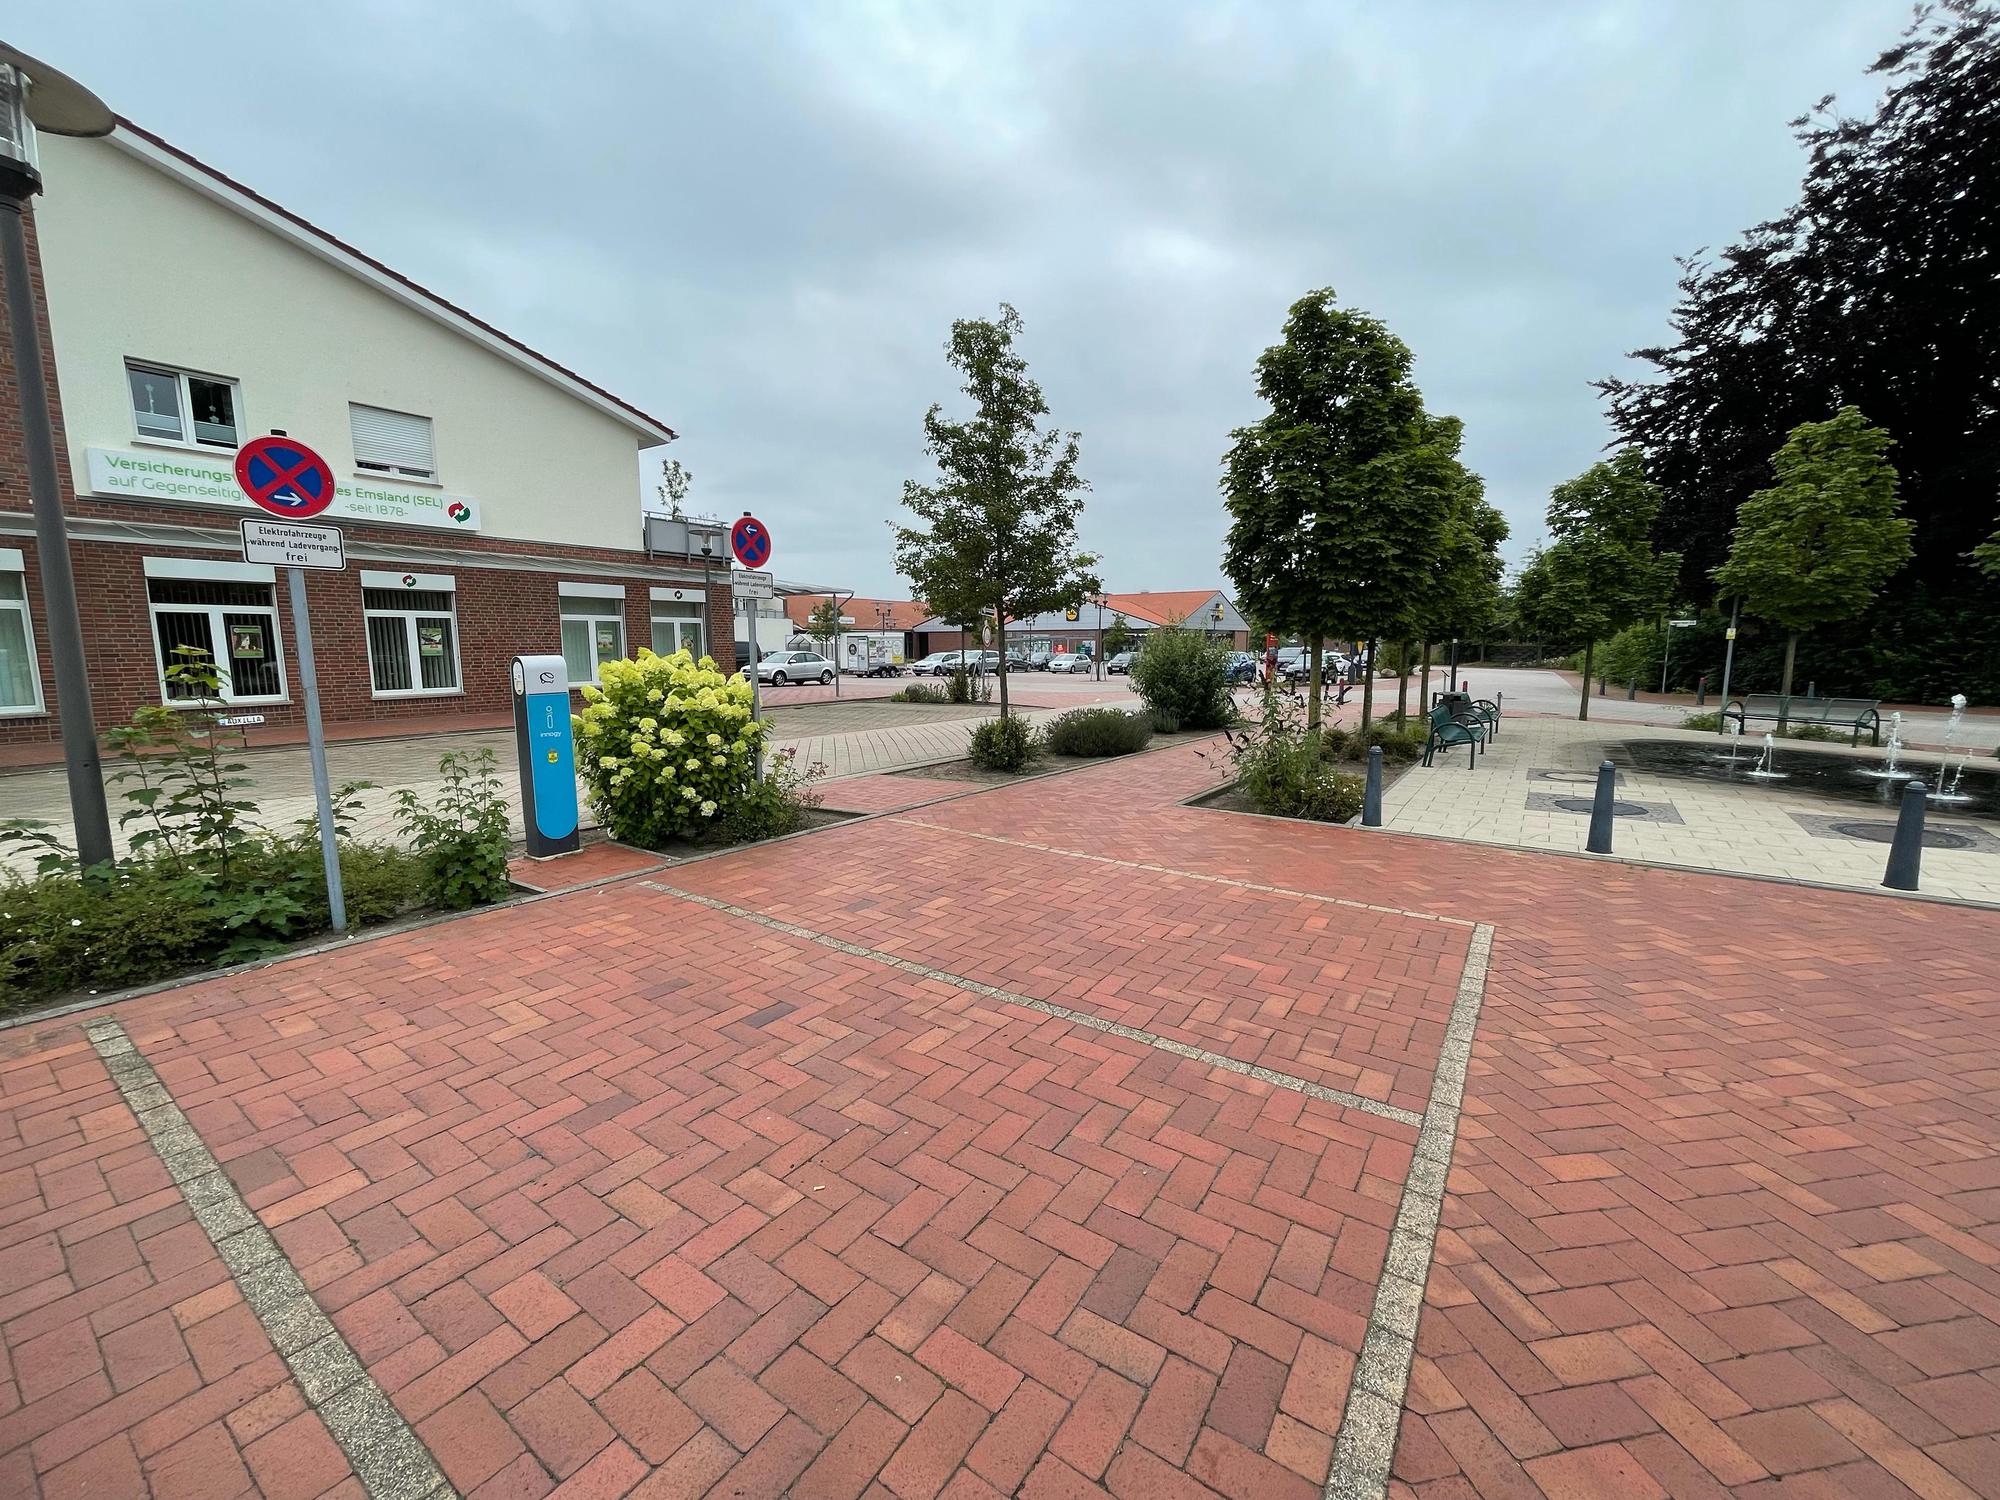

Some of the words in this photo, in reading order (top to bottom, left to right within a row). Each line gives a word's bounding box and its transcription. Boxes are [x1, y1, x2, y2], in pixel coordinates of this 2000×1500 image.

[105, 455, 235, 482] Versicherungs
[335, 486, 352, 497] es
[355, 487, 410, 504] Emsland
[413, 495, 443, 510] (SEL)
[108, 475, 138, 488] auf
[258, 526, 327, 541] Elektrofahrzeuge
[285, 551, 308, 562] frei
